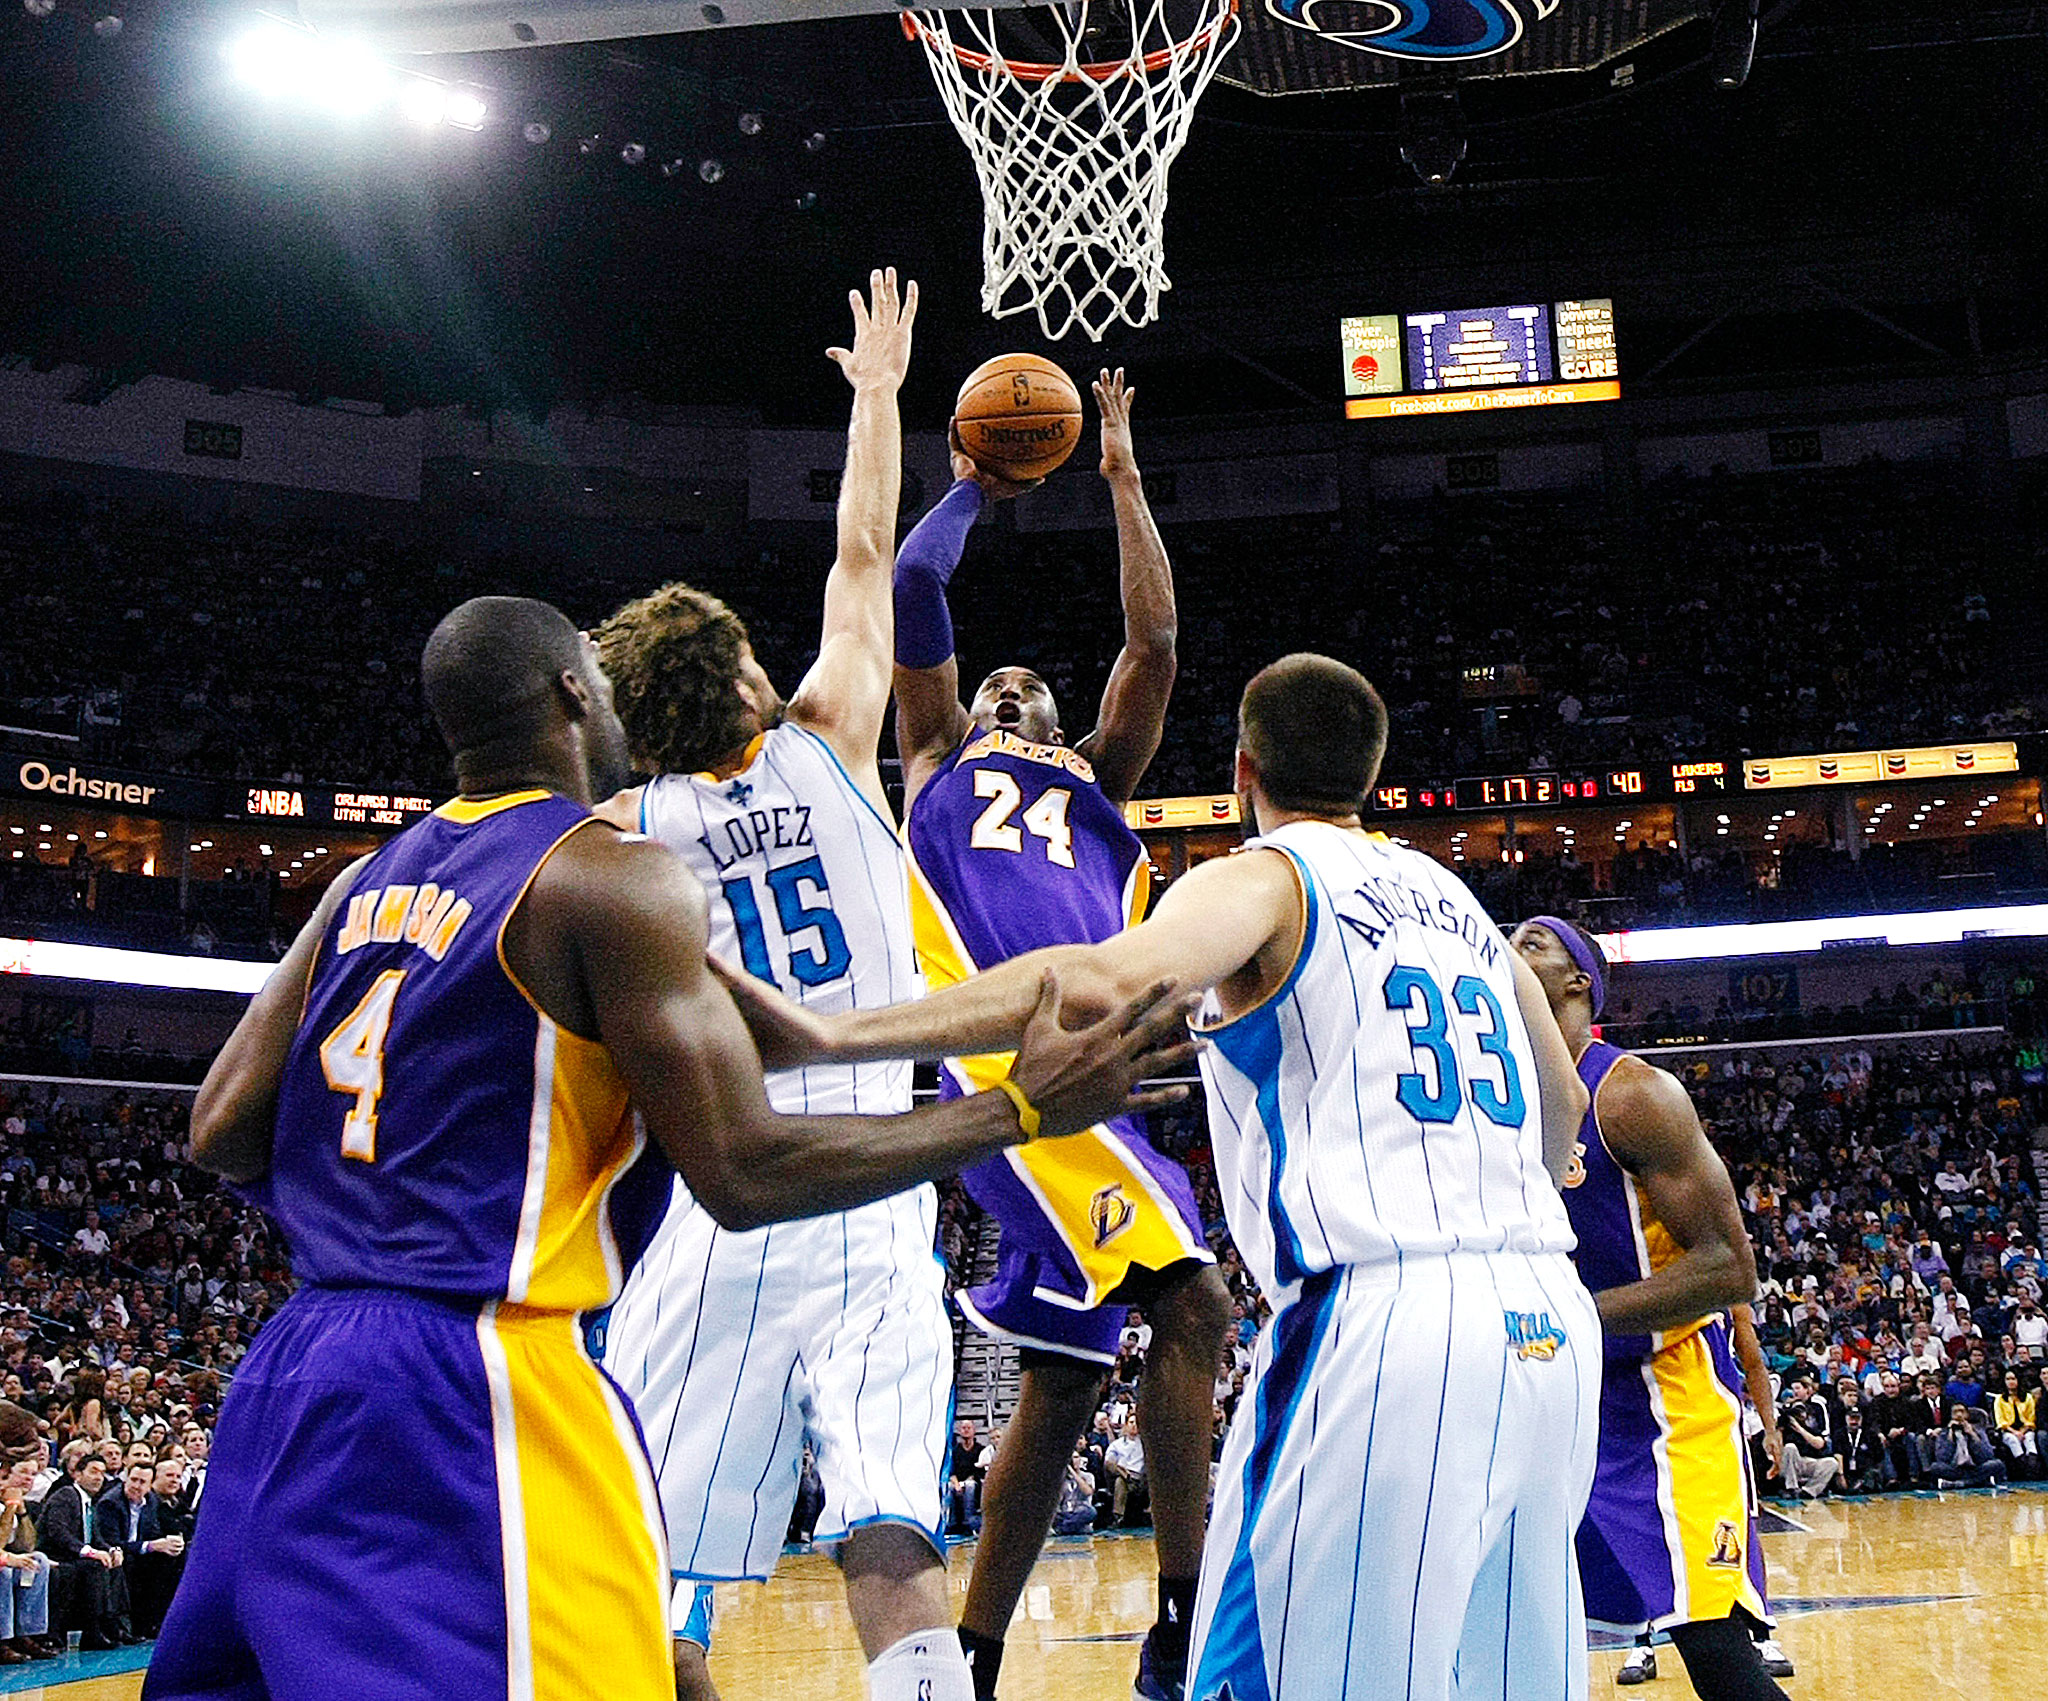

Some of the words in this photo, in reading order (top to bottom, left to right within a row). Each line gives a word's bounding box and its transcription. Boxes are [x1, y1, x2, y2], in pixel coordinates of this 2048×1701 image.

[1560, 309, 1600, 325] power
[1341, 325, 1382, 339] Power
[1556, 322, 1585, 339] help
[1355, 335, 1397, 352] People
[1576, 333, 1617, 351] need.
[1560, 359, 1618, 380] CARE
[1673, 763, 1724, 778] LAKERS
[20, 762, 155, 805] Ochsner
[1378, 787, 1408, 809] 45
[1613, 772, 1642, 793] 40
[1714, 777, 1725, 790] 4
[260, 790, 304, 817] NBA
[334, 793, 388, 808] ORLANDO
[393, 797, 432, 811] MAGIC
[333, 808, 366, 822] UTAH
[370, 810, 403, 825] JAZZ
[970, 769, 1077, 869] 24
[697, 806, 813, 871] LOPEZ
[722, 853, 853, 993] 15
[1382, 964, 1527, 1129] 33
[319, 968, 408, 1164] 4
